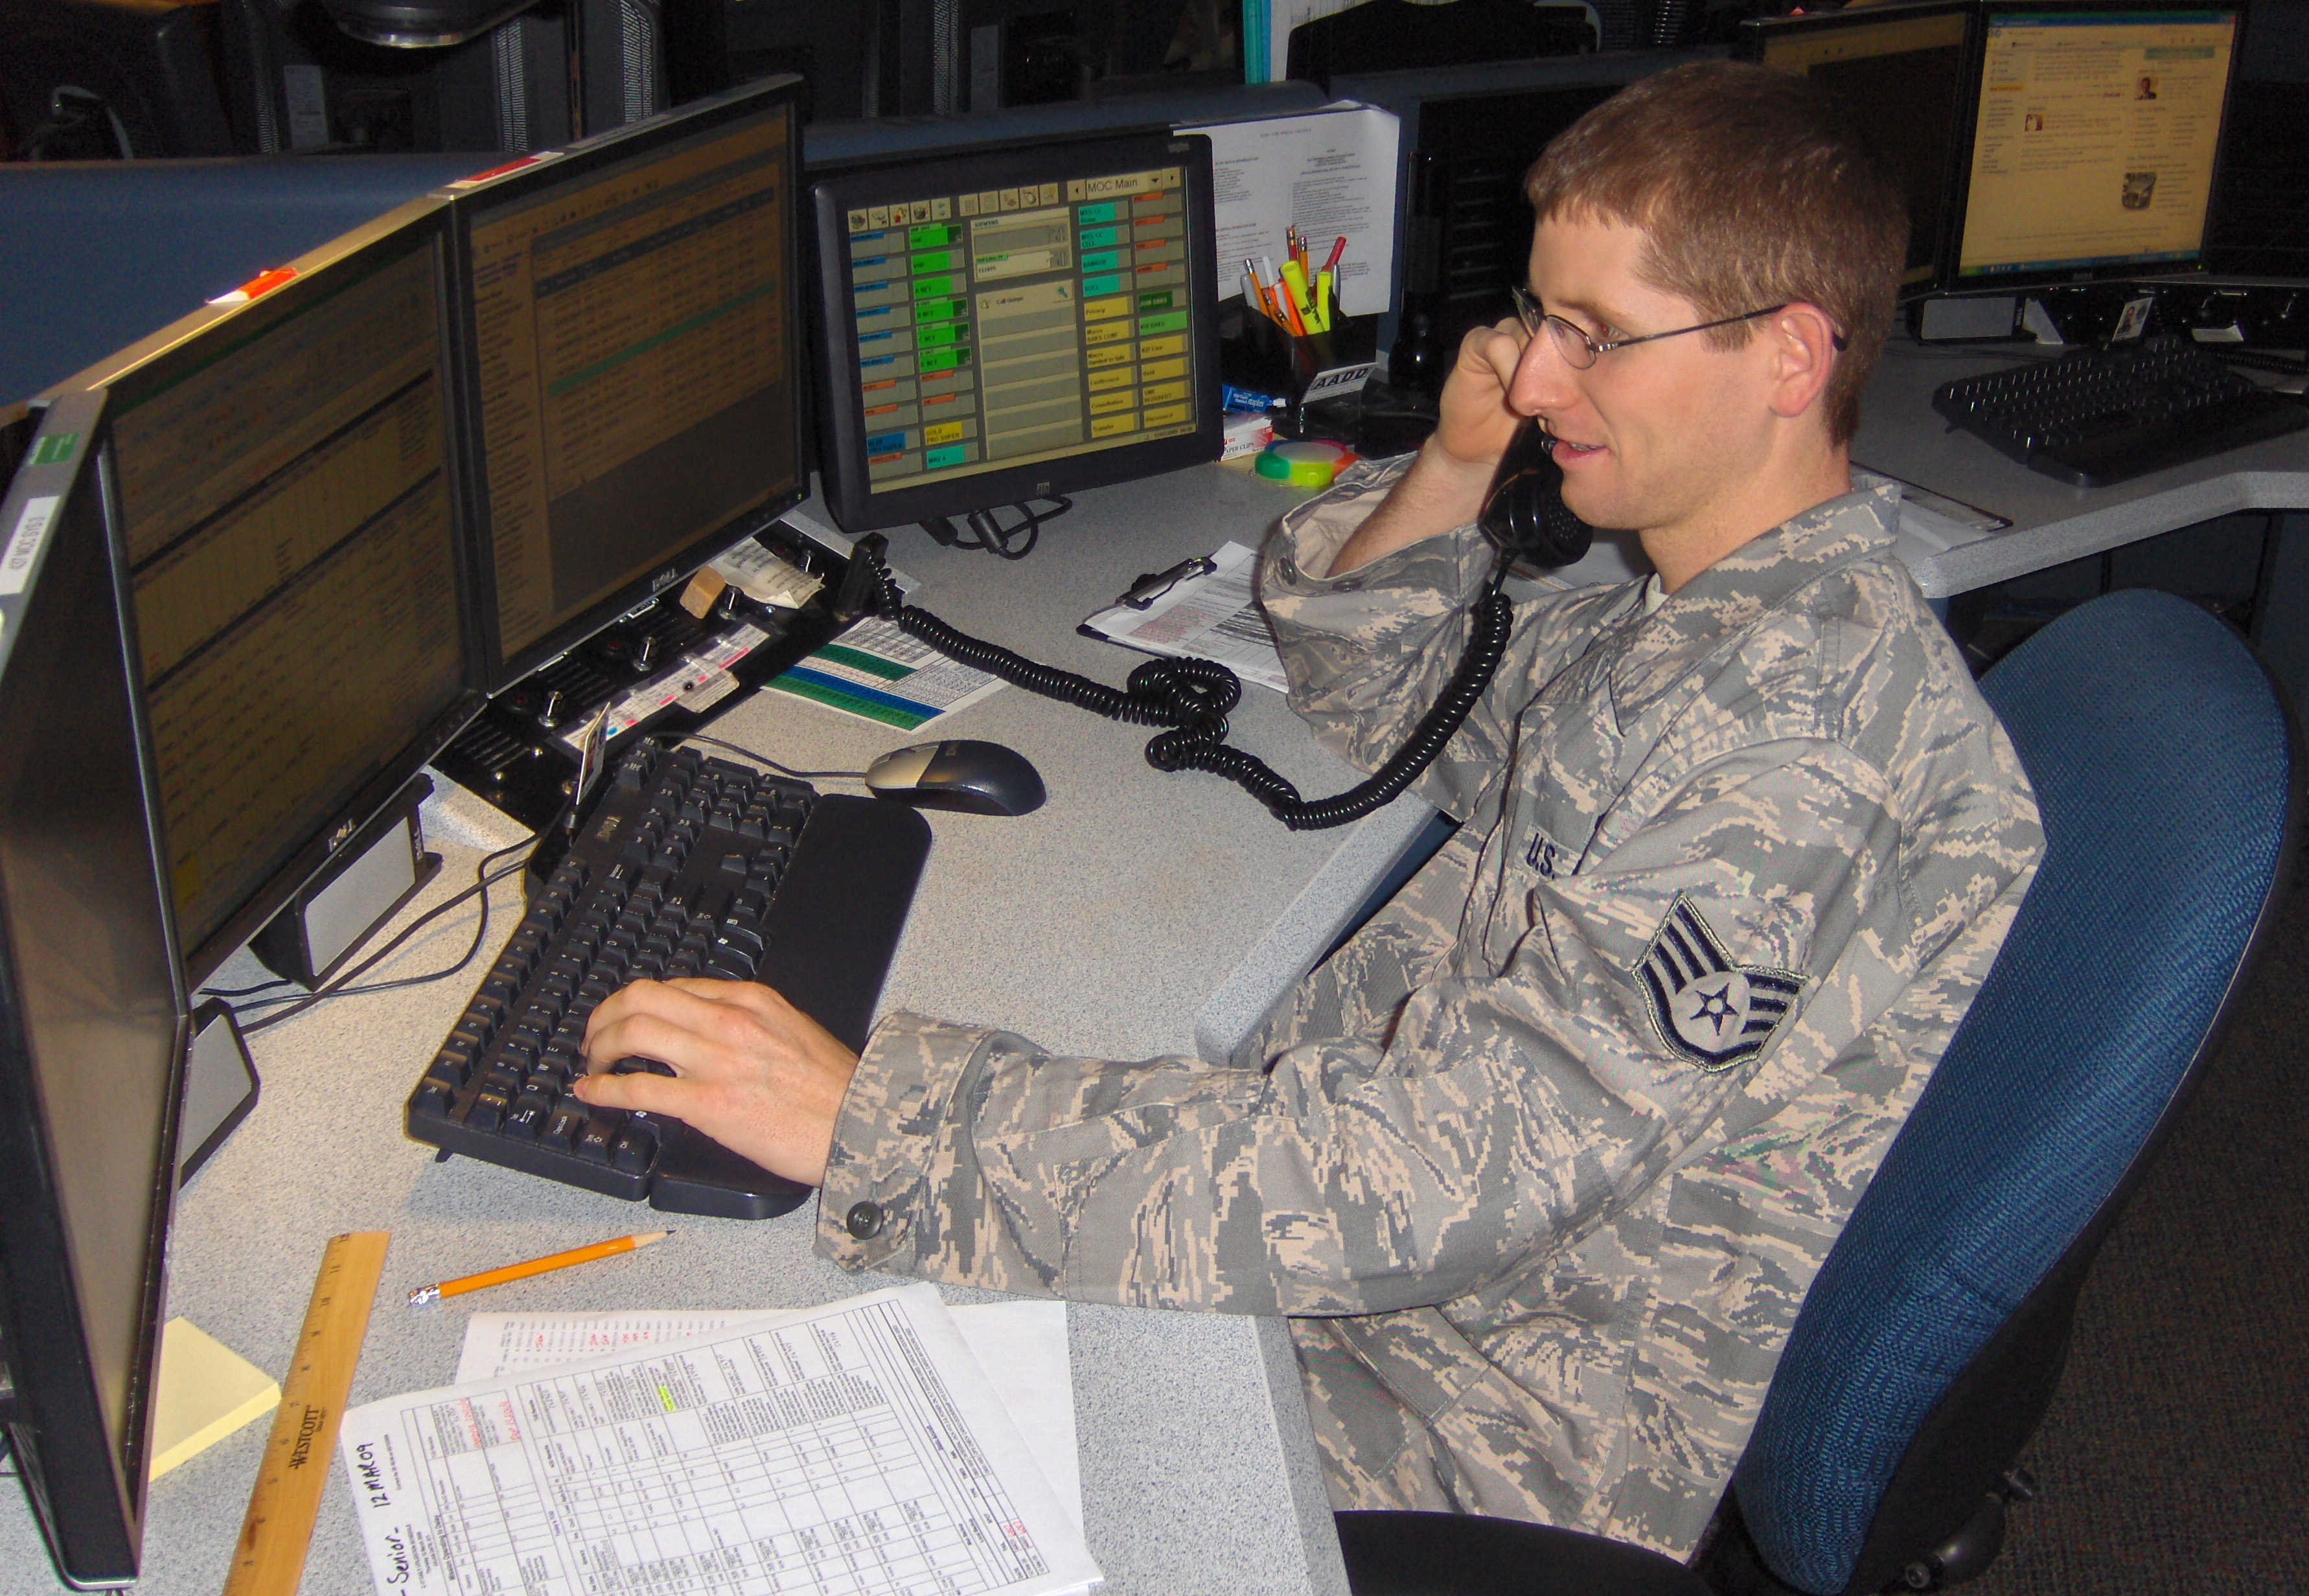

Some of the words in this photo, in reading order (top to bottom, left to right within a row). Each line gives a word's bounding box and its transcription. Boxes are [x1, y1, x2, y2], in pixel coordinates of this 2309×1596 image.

[1088, 181, 1112, 193] MOC
[1115, 178, 1138, 190] Main
[1090, 376, 1120, 386] Conference
[1091, 399, 1123, 409] Consultation
[1248, 398, 1265, 408] staples
[288, 1404, 319, 1470] WESTCOTT
[370, 1492, 391, 1509] 12
